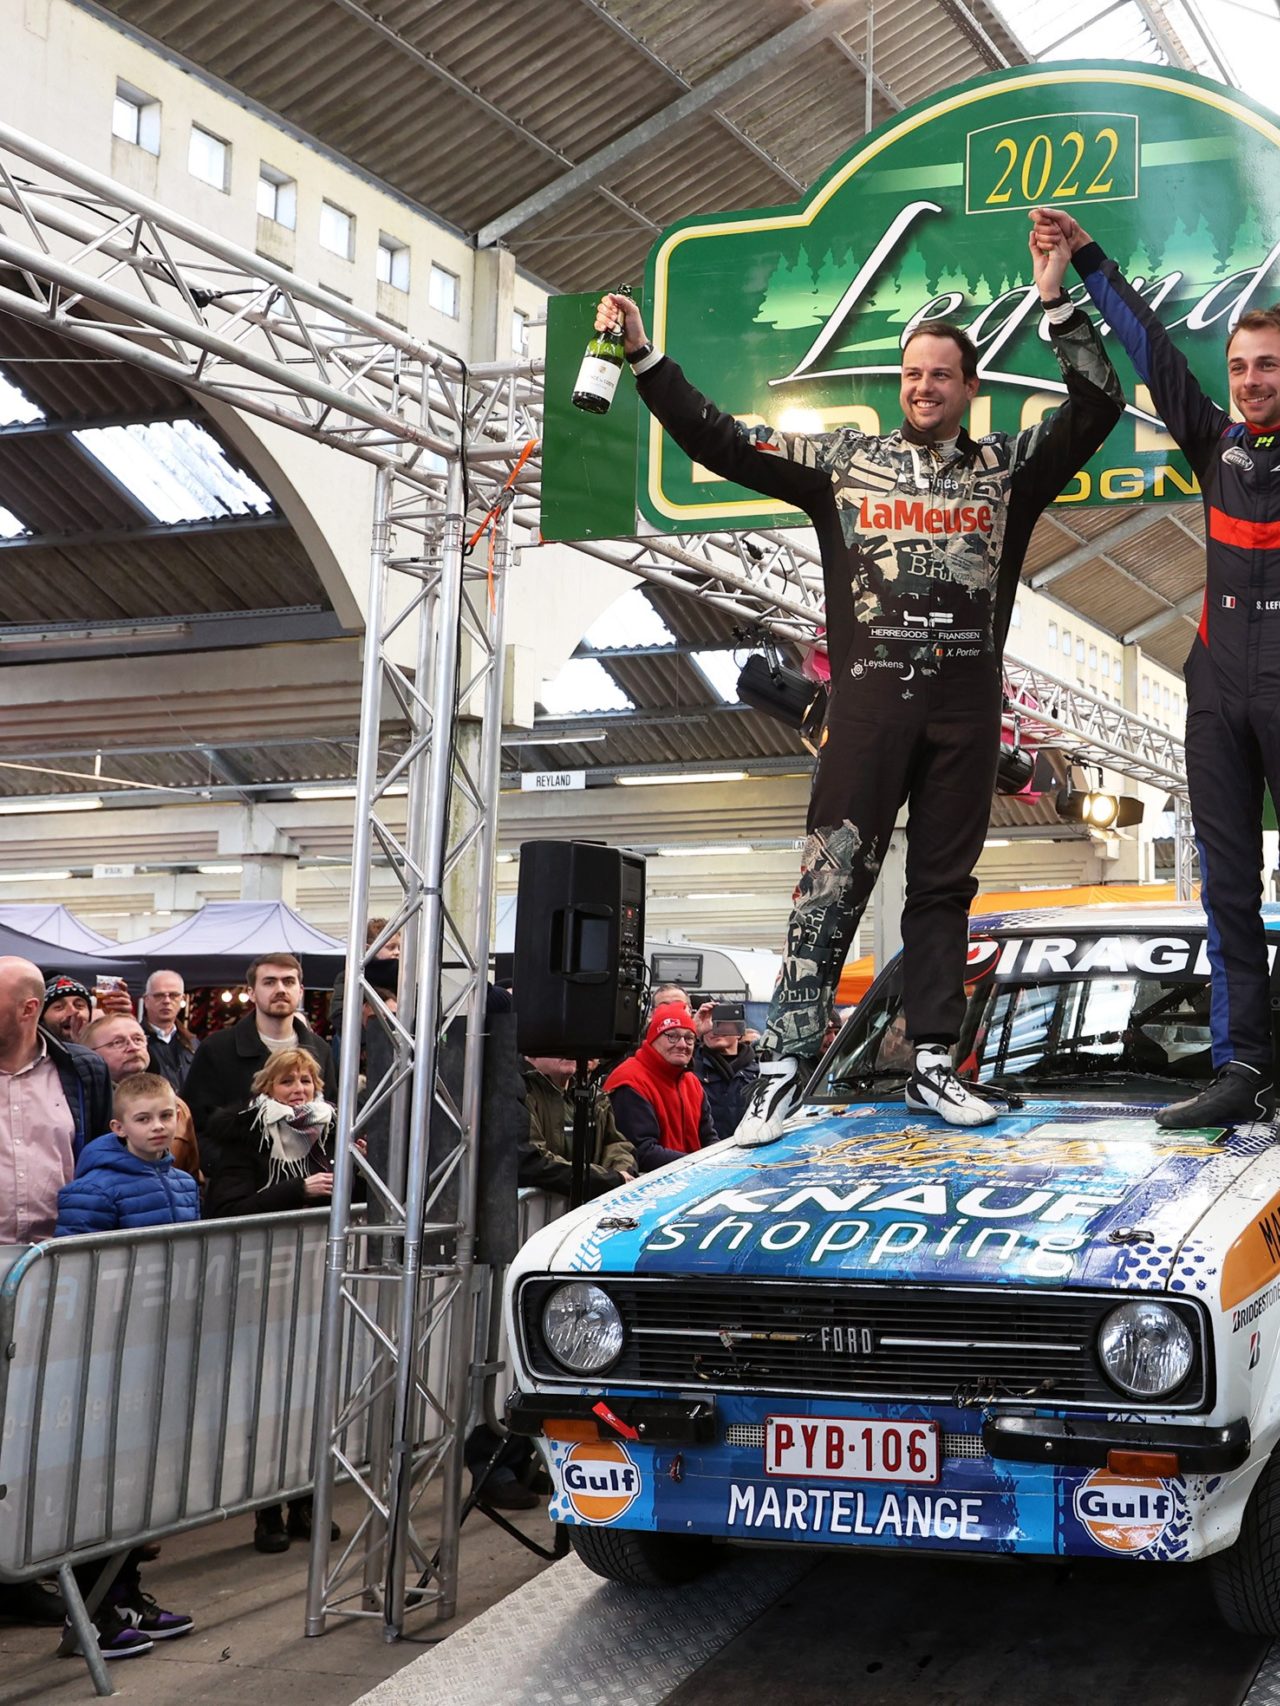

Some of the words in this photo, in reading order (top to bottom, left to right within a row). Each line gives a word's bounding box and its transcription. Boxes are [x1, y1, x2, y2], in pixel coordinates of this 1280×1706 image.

[985, 128, 1119, 203] 2022
[860, 496, 991, 535] LaMeuse
[870, 628, 929, 639] HERREGODS
[938, 631, 980, 640] FRANSSEN
[863, 658, 905, 670] Leyskens
[946, 648, 955, 657] X.
[956, 647, 981, 657] Portier
[536, 774, 571, 787] REYLAND
[684, 1184, 1130, 1224] KNAUF
[646, 1218, 1098, 1278] shopping
[820, 1326, 873, 1355] FORD
[562, 1462, 635, 1492] Gulf
[727, 1484, 983, 1542] MARTELANGE
[1078, 1492, 1172, 1522] Gulf
